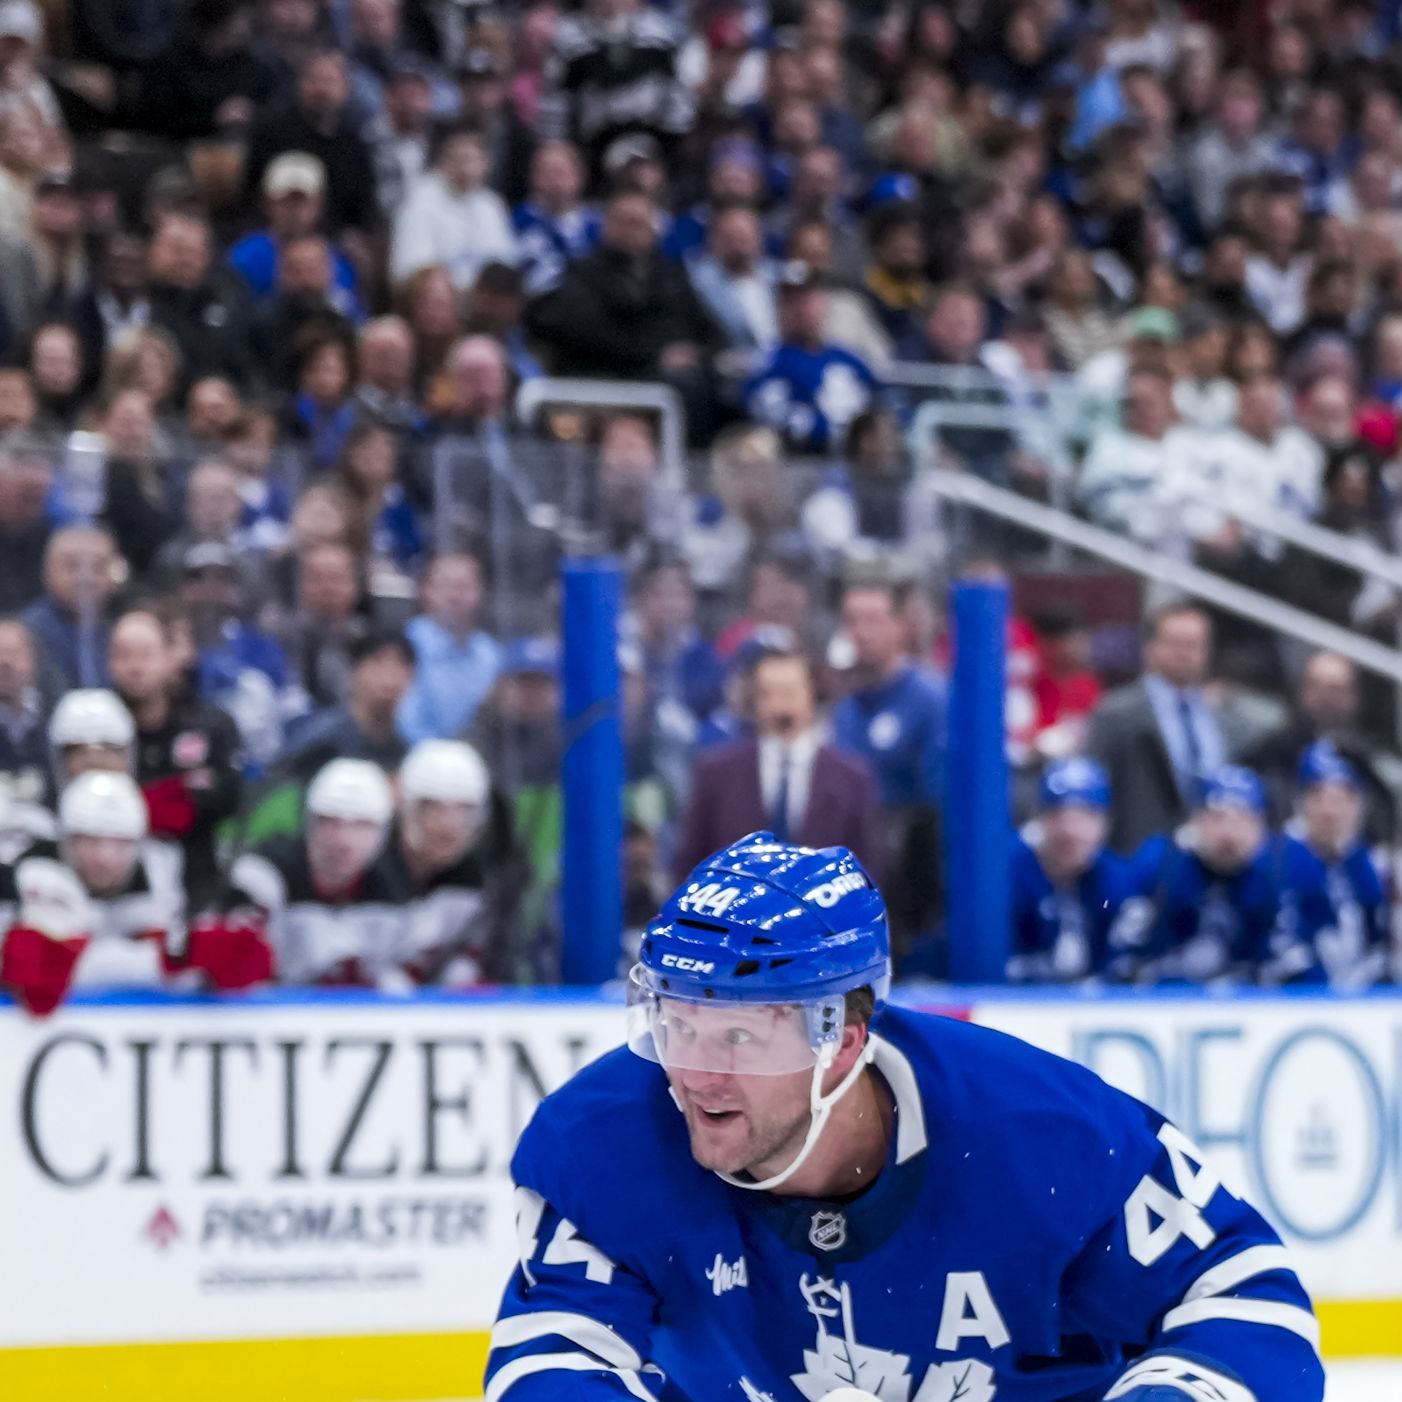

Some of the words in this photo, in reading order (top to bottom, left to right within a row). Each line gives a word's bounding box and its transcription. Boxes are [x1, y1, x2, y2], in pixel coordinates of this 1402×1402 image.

[687, 882, 741, 918] 44
[661, 953, 715, 974] CCM
[1123, 1122, 1243, 1267] 44
[201, 1204, 488, 1248] PROMASTER
[936, 1271, 1011, 1351] A
